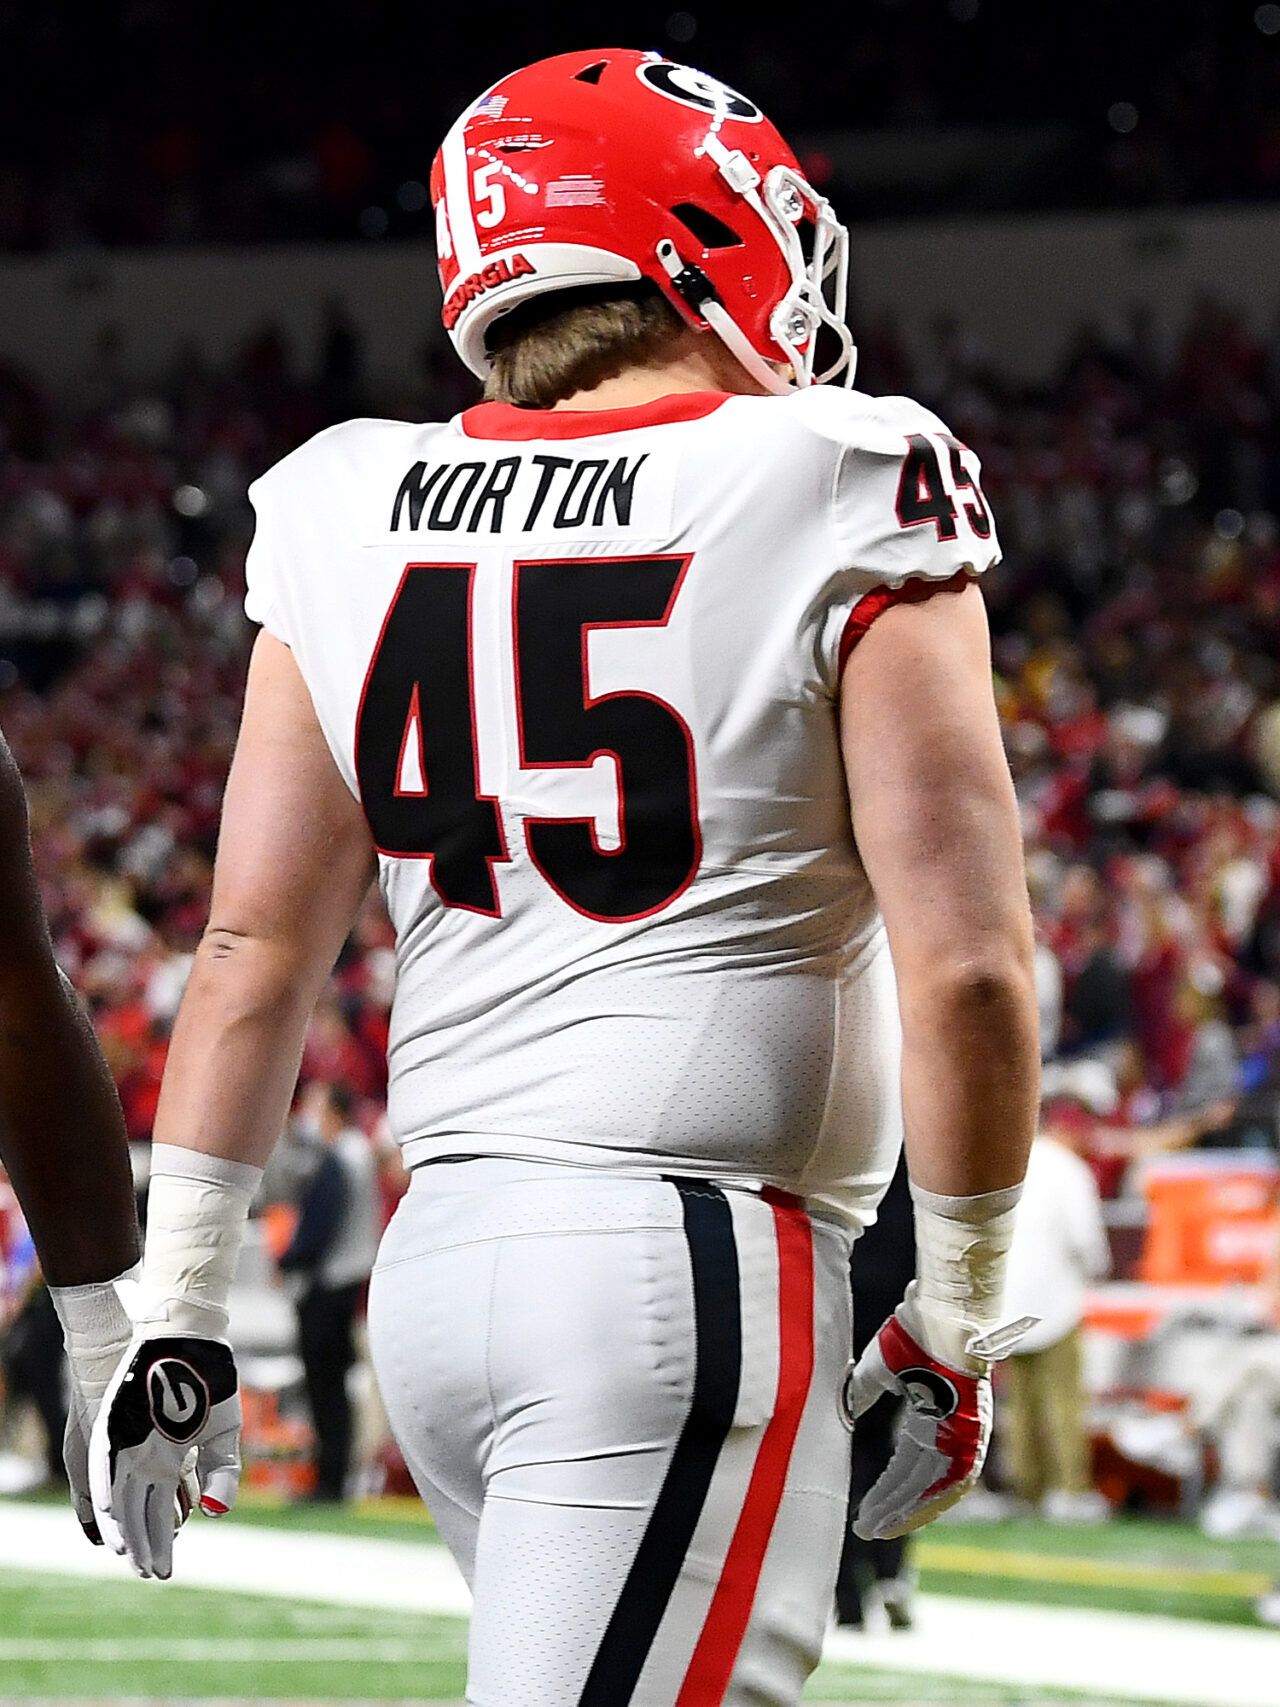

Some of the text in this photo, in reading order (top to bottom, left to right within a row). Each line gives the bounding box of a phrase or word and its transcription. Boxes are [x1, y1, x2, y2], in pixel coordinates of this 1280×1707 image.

[390, 453, 650, 533] NORTON
[894, 433, 991, 542] 45
[354, 552, 703, 924] 45
